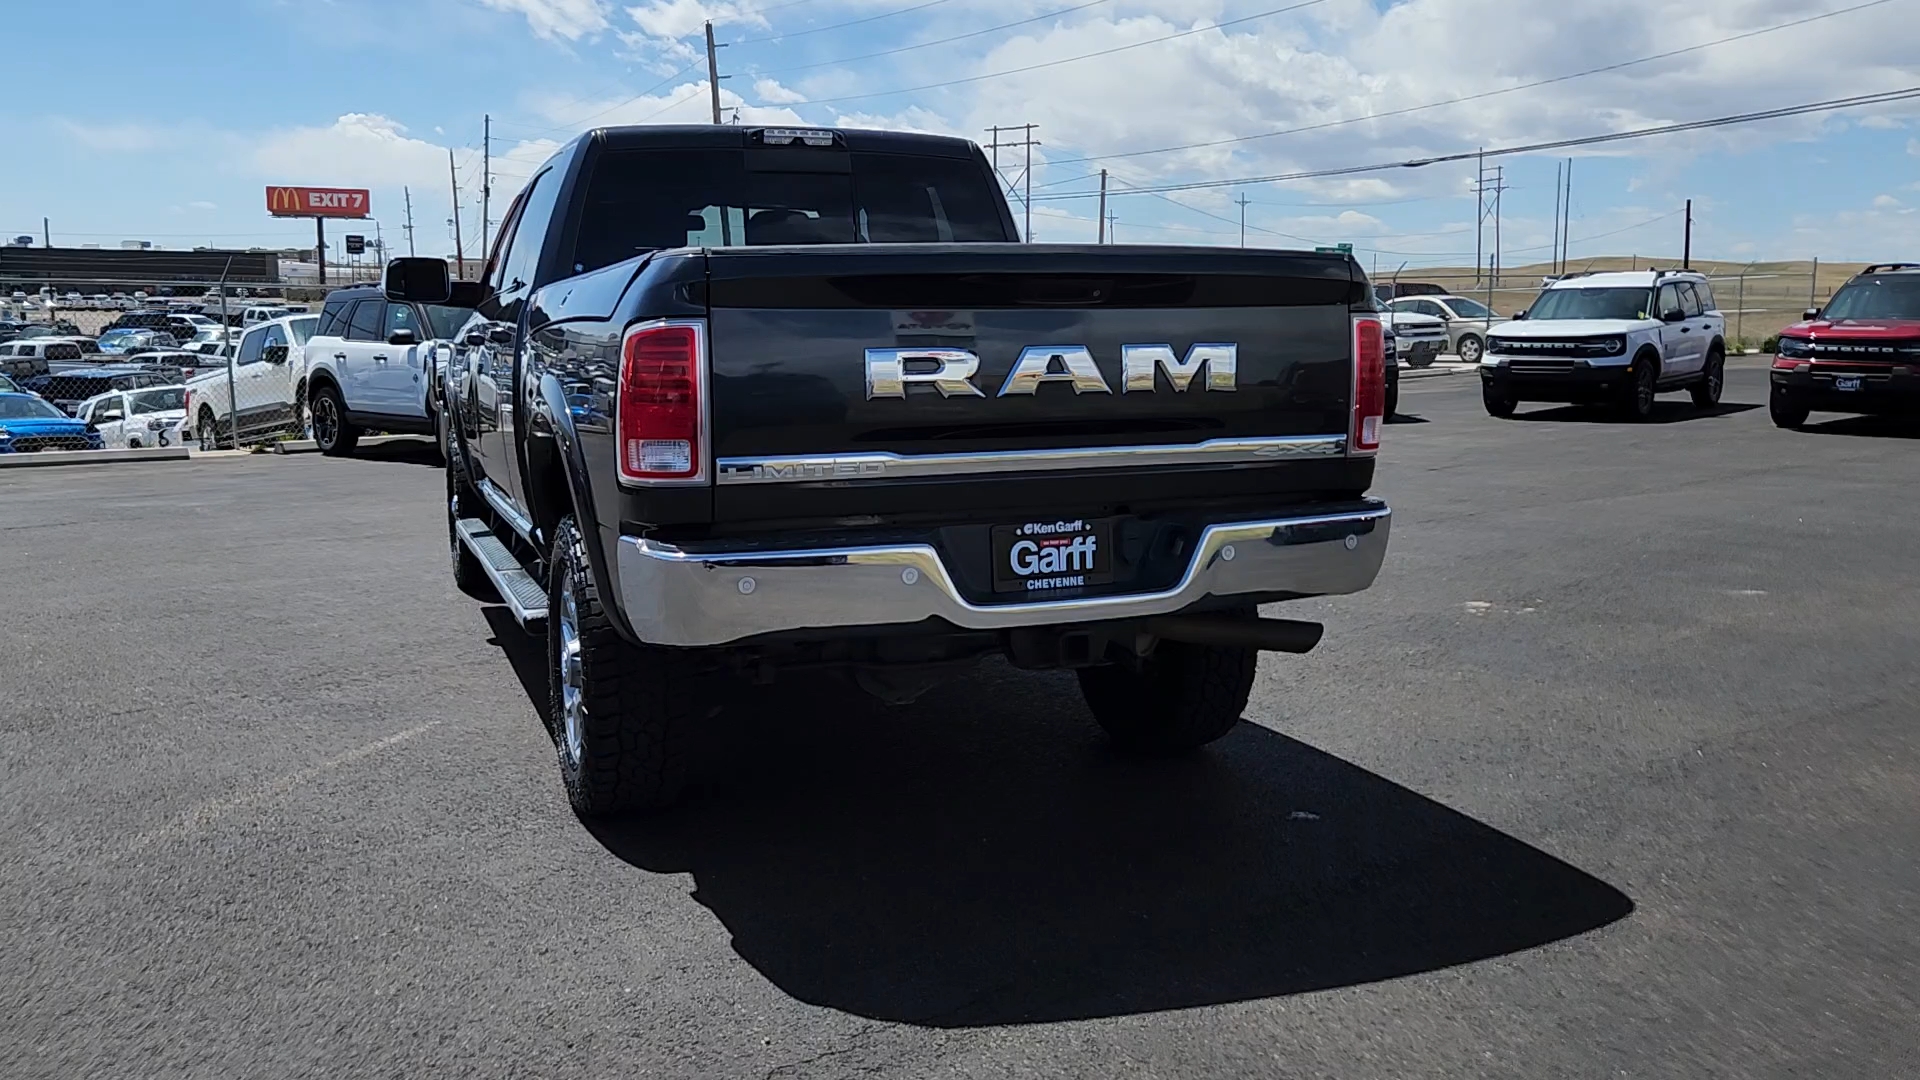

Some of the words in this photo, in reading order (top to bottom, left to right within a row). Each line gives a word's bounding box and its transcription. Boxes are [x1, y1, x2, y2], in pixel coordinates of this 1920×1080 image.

[309, 192, 349, 208] EXIT
[352, 193, 364, 208] 7
[864, 342, 1238, 401] RAM
[727, 461, 887, 480] LIMITED
[1034, 523, 1054, 534] Ken
[1056, 520, 1083, 532] Garff
[1010, 535, 1097, 576] Garff
[1026, 576, 1084, 590] CHEYENNE
